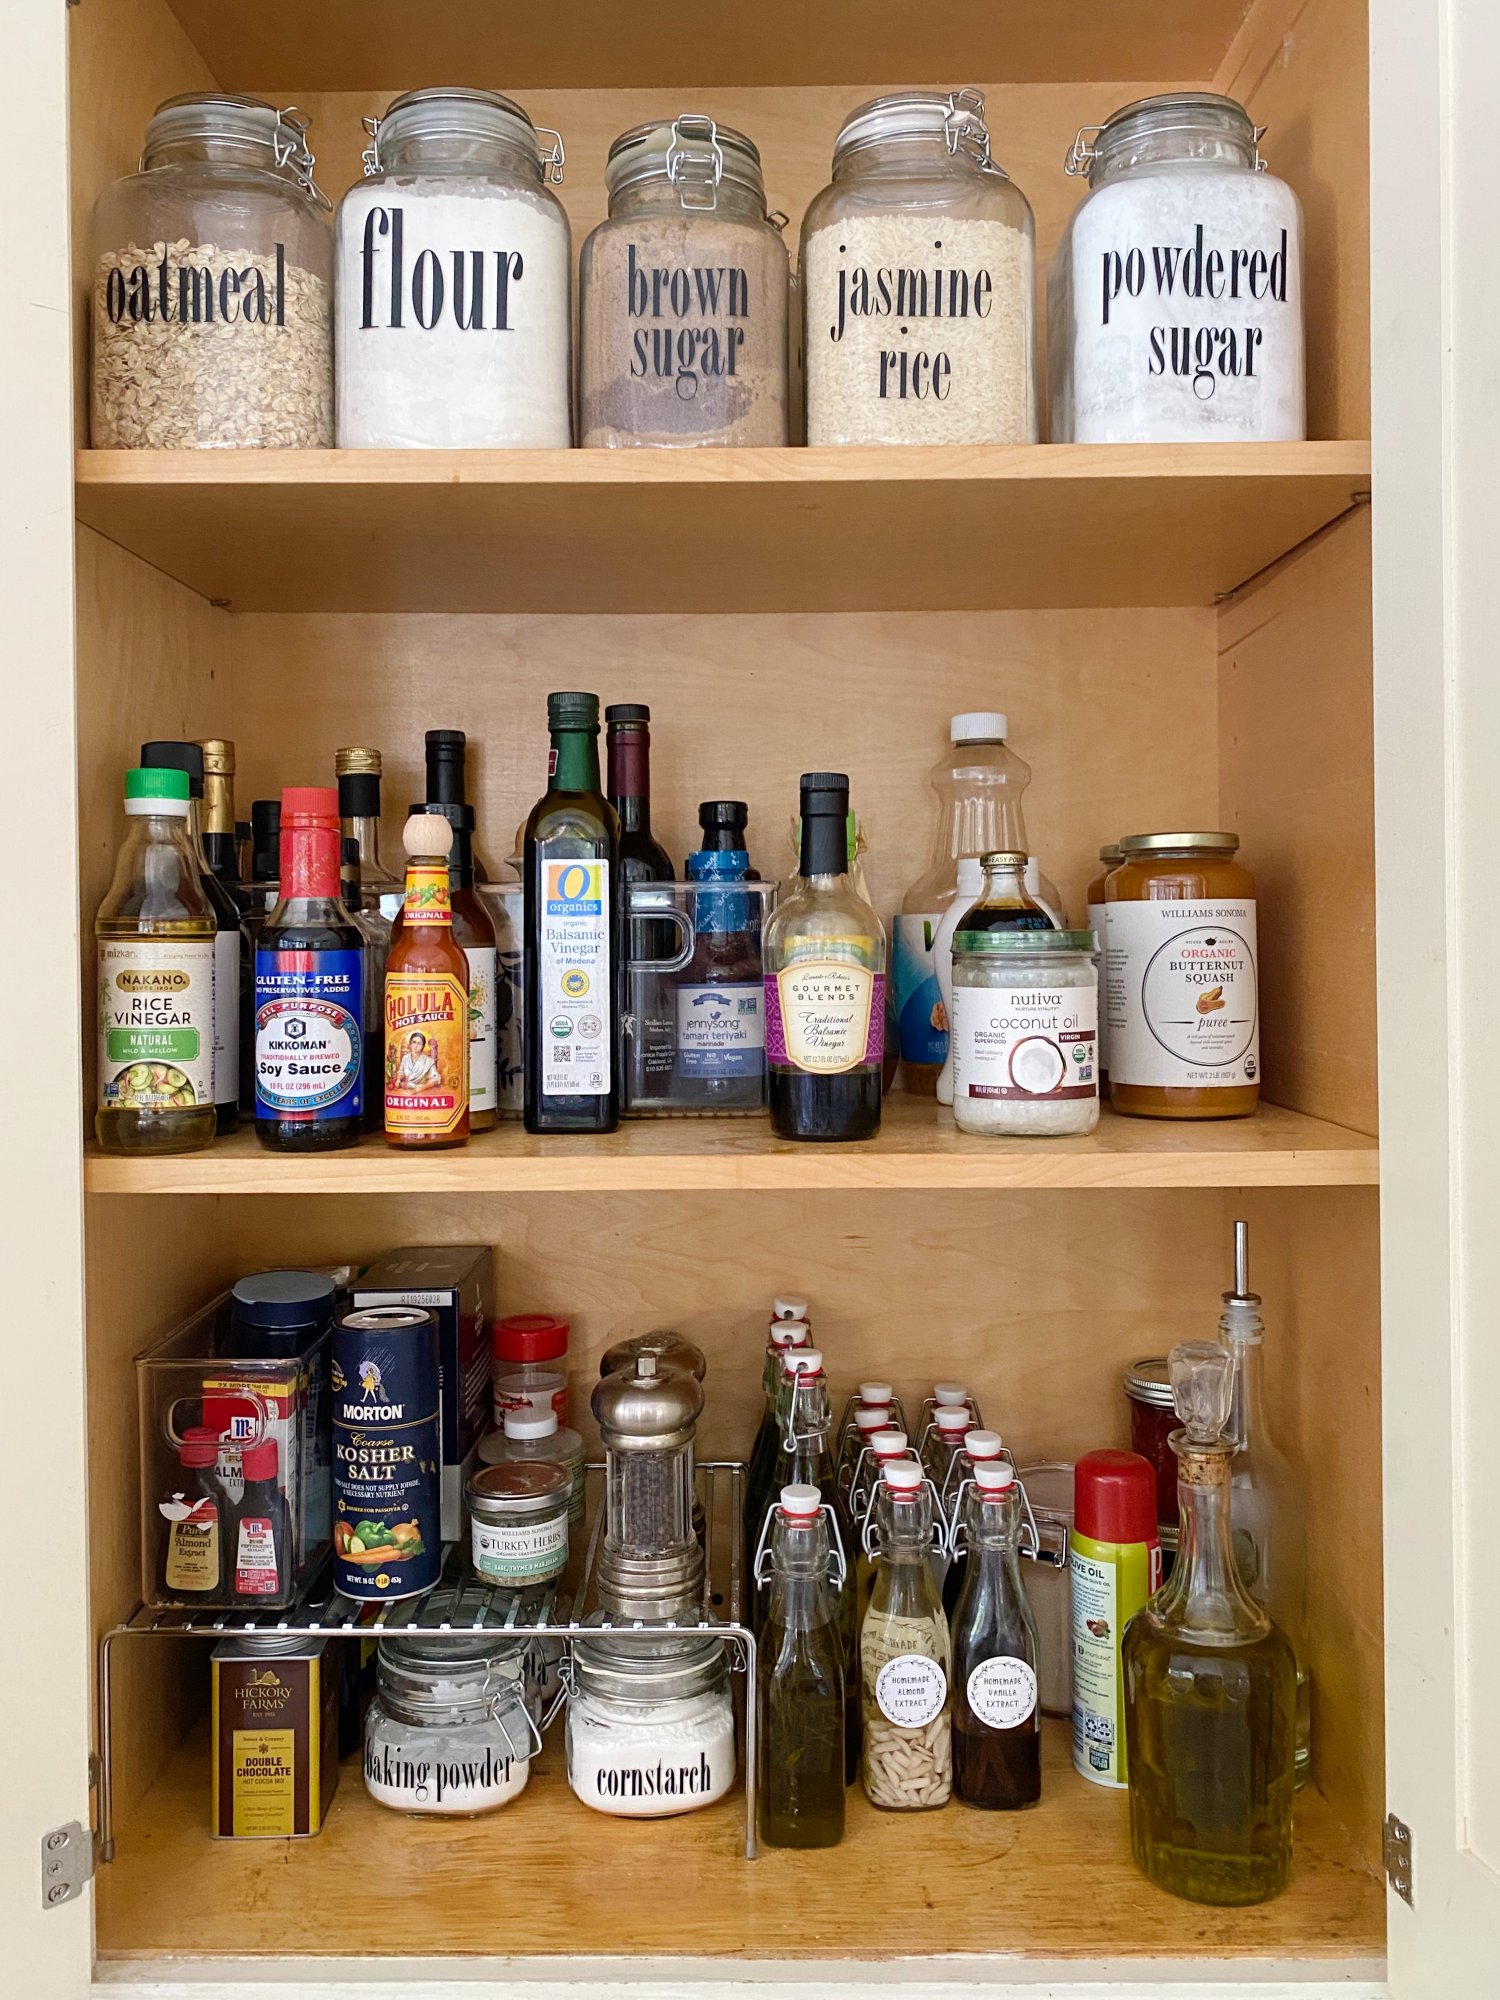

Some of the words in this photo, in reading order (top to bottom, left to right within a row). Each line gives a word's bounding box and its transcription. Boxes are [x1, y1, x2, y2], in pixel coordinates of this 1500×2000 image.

[358, 208, 524, 330] flour
[1100, 224, 1289, 324] powdered
[105, 242, 285, 326] oatmeal
[627, 245, 750, 318] brown
[830, 240, 993, 342] jasmine
[629, 324, 744, 400] sugar
[879, 326, 952, 400] rice
[1147, 323, 1263, 400] sugar
[550, 902, 598, 913] organics
[405, 912, 444, 920] ORIGINAL
[1161, 910, 1214, 918] WILLIAMS
[1215, 910, 1247, 918] SONOMA
[546, 928, 605, 940] Balsamic
[107, 949, 135, 958] mizkan
[551, 942, 600, 956] Vinegar
[1181, 949, 1236, 959] ORGANIC
[1170, 961, 1244, 971] BUTTERNUT
[122, 975, 183, 984] NAKANO
[256, 975, 350, 985] GLUTEN-FREE
[1185, 973, 1234, 985] SQUASH
[132, 998, 172, 1011] RICE
[1011, 993, 1061, 1005] nutiva
[260, 1002, 338, 1019] ALL-PURPOSE
[385, 992, 453, 1022] CHOLULA
[114, 1012, 191, 1025] VINEGAR
[396, 1017, 416, 1028] HOT
[418, 1013, 448, 1022] SAUCE
[799, 1011, 853, 1024] Traditional
[990, 1016, 1058, 1029] coconut
[1063, 1014, 1078, 1028] oil
[686, 1020, 739, 1030] jennysong
[804, 1025, 847, 1035] Balsamic
[1197, 1017, 1228, 1031] puree
[130, 1035, 173, 1045] NATURAL
[683, 1032, 709, 1040] tamari
[712, 1031, 747, 1040] teriyaki
[269, 1041, 327, 1050] KIKKOMAN
[806, 1036, 845, 1049] Vinegar
[260, 1062, 282, 1077] Soy
[288, 1063, 341, 1075] Sauce
[387, 1096, 448, 1107] ORIGINAL
[343, 1404, 402, 1420] MORTON
[351, 1432, 394, 1447] Coarse
[337, 1444, 415, 1464] KOSHER
[348, 1464, 397, 1480] SALT
[351, 1483, 364, 1491] DOES
[378, 1483, 400, 1491] SUPPLY
[376, 1489, 405, 1497] NUTRIENT
[531, 1525, 553, 1534] SONOMA
[175, 1537, 211, 1547] Almond
[490, 1539, 530, 1550] TURKEY
[534, 1531, 560, 1548] HERBS
[179, 1548, 206, 1557] Extract
[1088, 1568, 1104, 1579] OIL
[892, 1676, 930, 1684] HOMEMADE
[984, 1677, 1021, 1685] HOMEMADE
[235, 1687, 293, 1699] HICKORY
[898, 1688, 925, 1696] ALMOND
[243, 1699, 284, 1710] FARMS
[895, 1699, 927, 1707] EXTRACT
[986, 1700, 1019, 1708] EXTRACT
[246, 1757, 282, 1766] DOUBLE
[237, 1767, 291, 1777] CHOCOLATE
[365, 1737, 430, 1802] baking
[435, 1747, 515, 1802] powder
[596, 1752, 712, 1797] cornstarch
